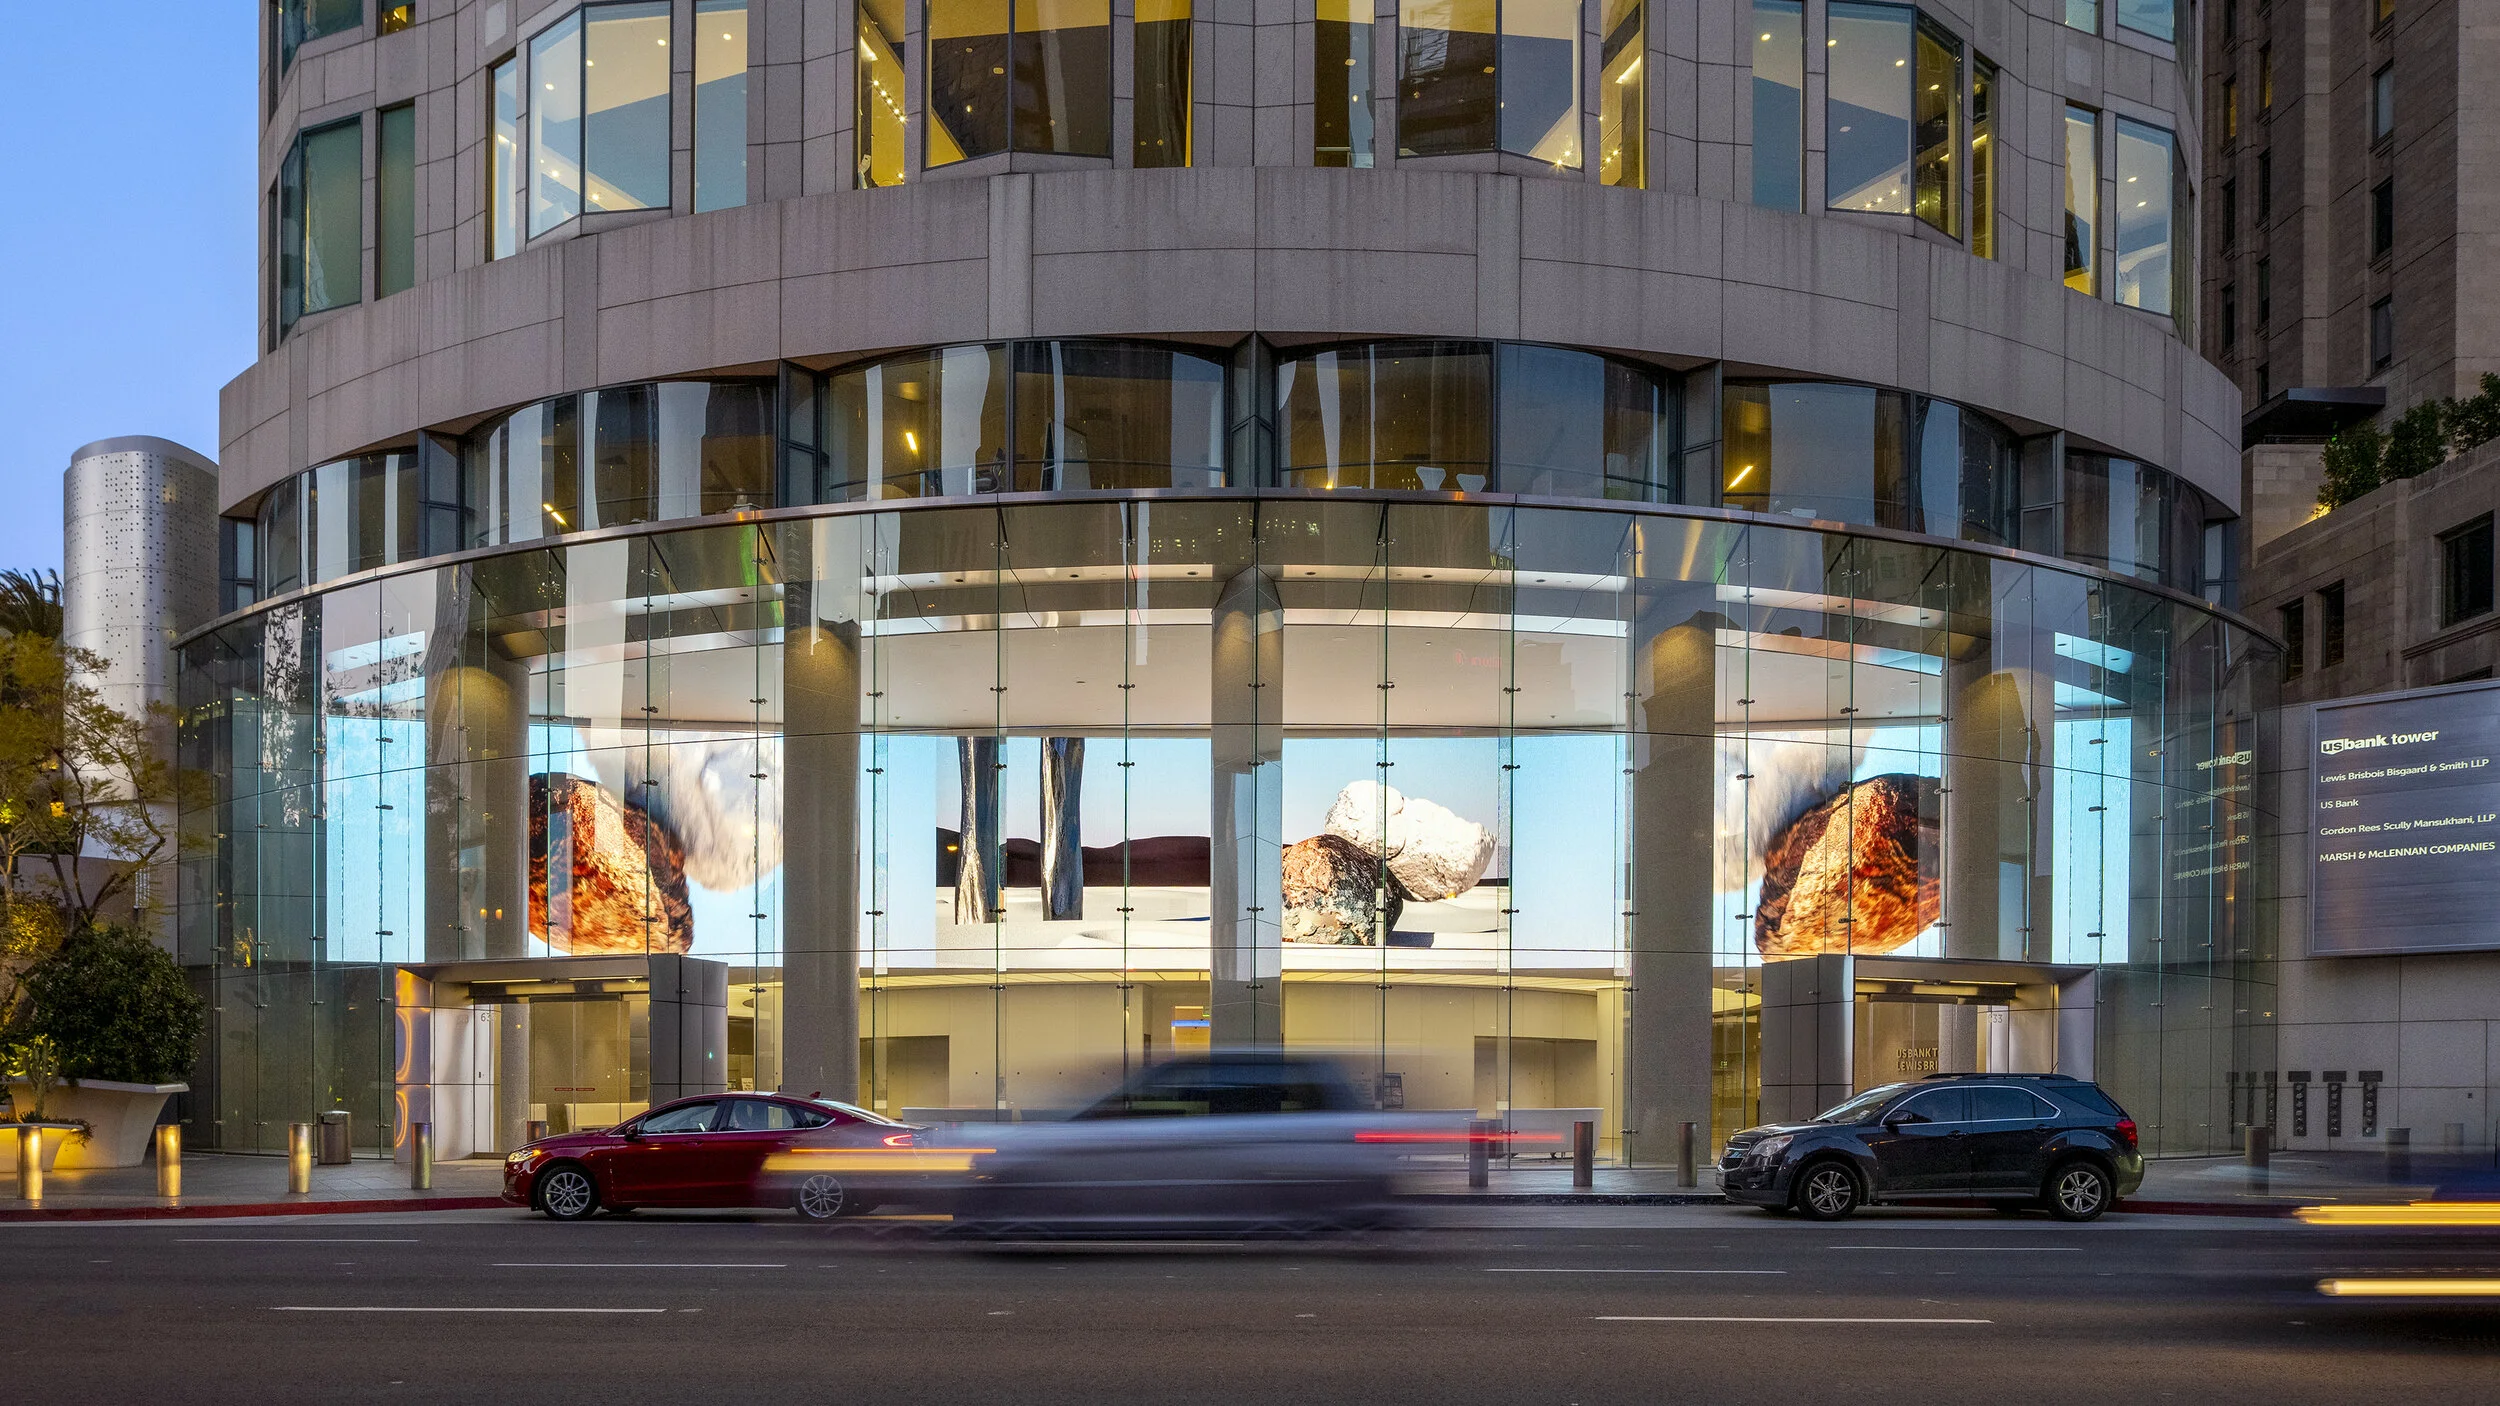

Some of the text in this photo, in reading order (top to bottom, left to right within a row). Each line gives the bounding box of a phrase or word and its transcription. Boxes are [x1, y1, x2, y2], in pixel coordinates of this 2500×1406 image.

[2391, 730, 2439, 745] tower
[2320, 758, 2490, 783] Lewis Brisbois Bisgaard & Smith LLP
[2320, 798, 2359, 809] US Bank
[2320, 813, 2497, 836] Gordon Rees Scully Mansukhani, LLP
[2320, 841, 2496, 862] MARSH & McLENNAN COMPANIES
